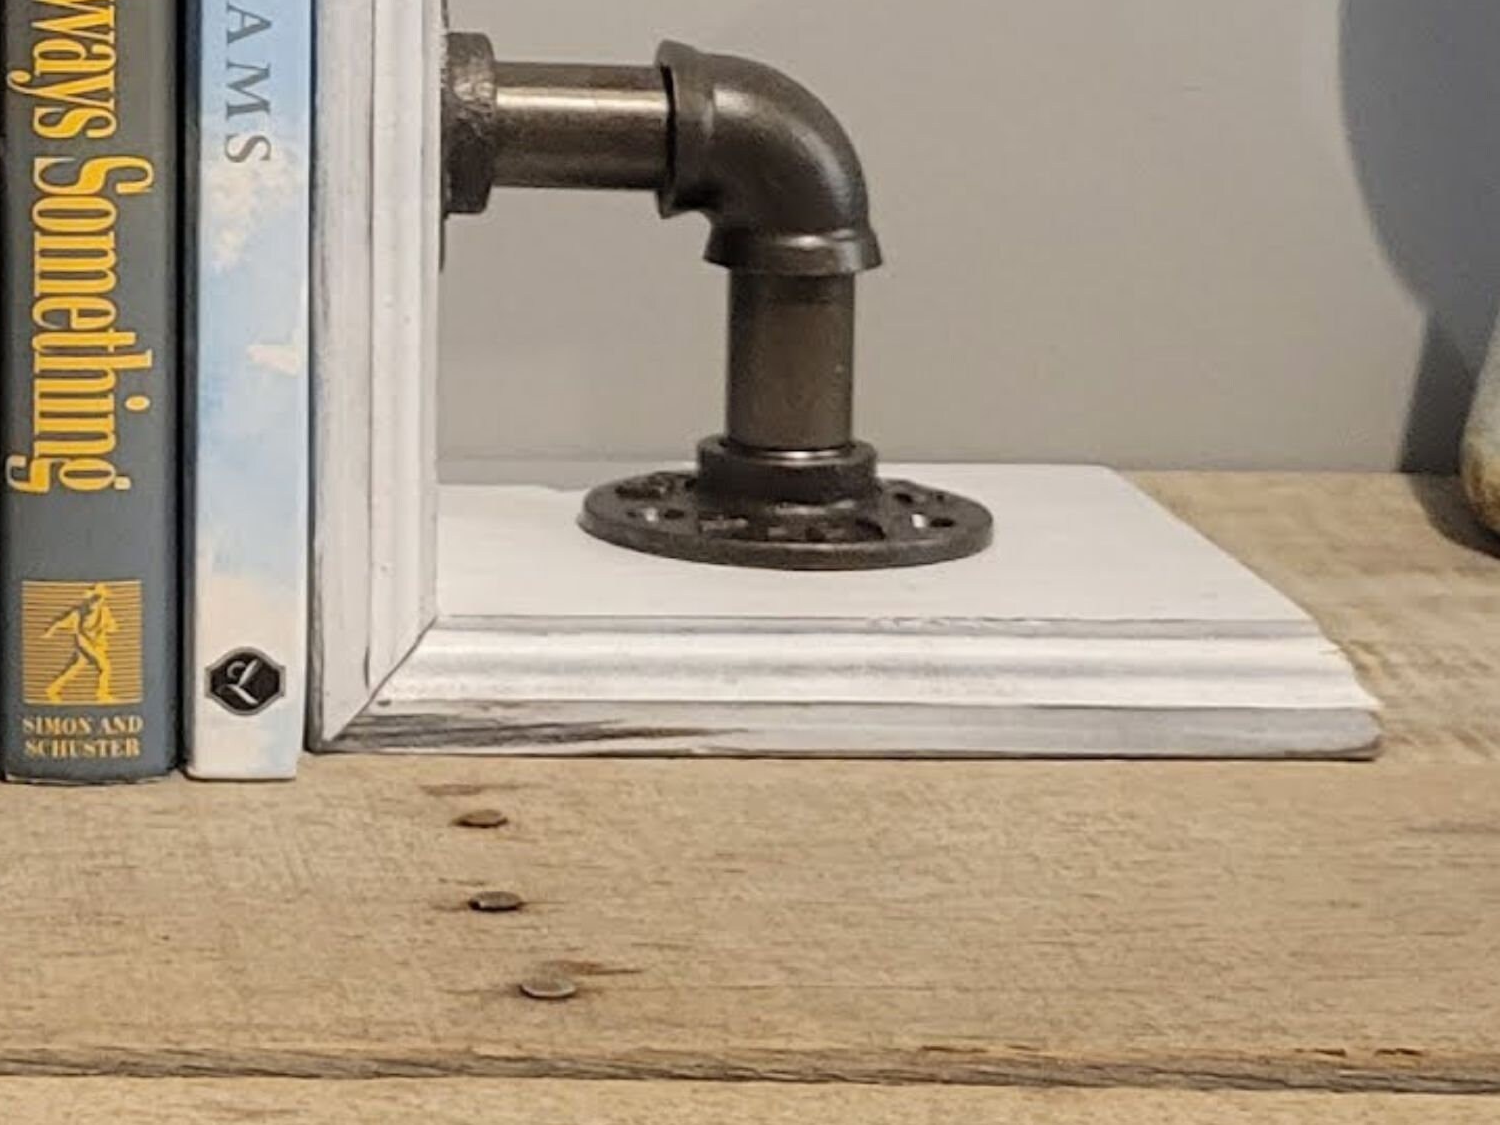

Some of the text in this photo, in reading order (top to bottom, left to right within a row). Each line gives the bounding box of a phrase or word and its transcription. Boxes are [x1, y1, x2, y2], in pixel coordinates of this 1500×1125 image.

[6, 155, 155, 494] Something
[21, 714, 145, 736] SIMON AND
[24, 737, 142, 759] SCHUSTER
